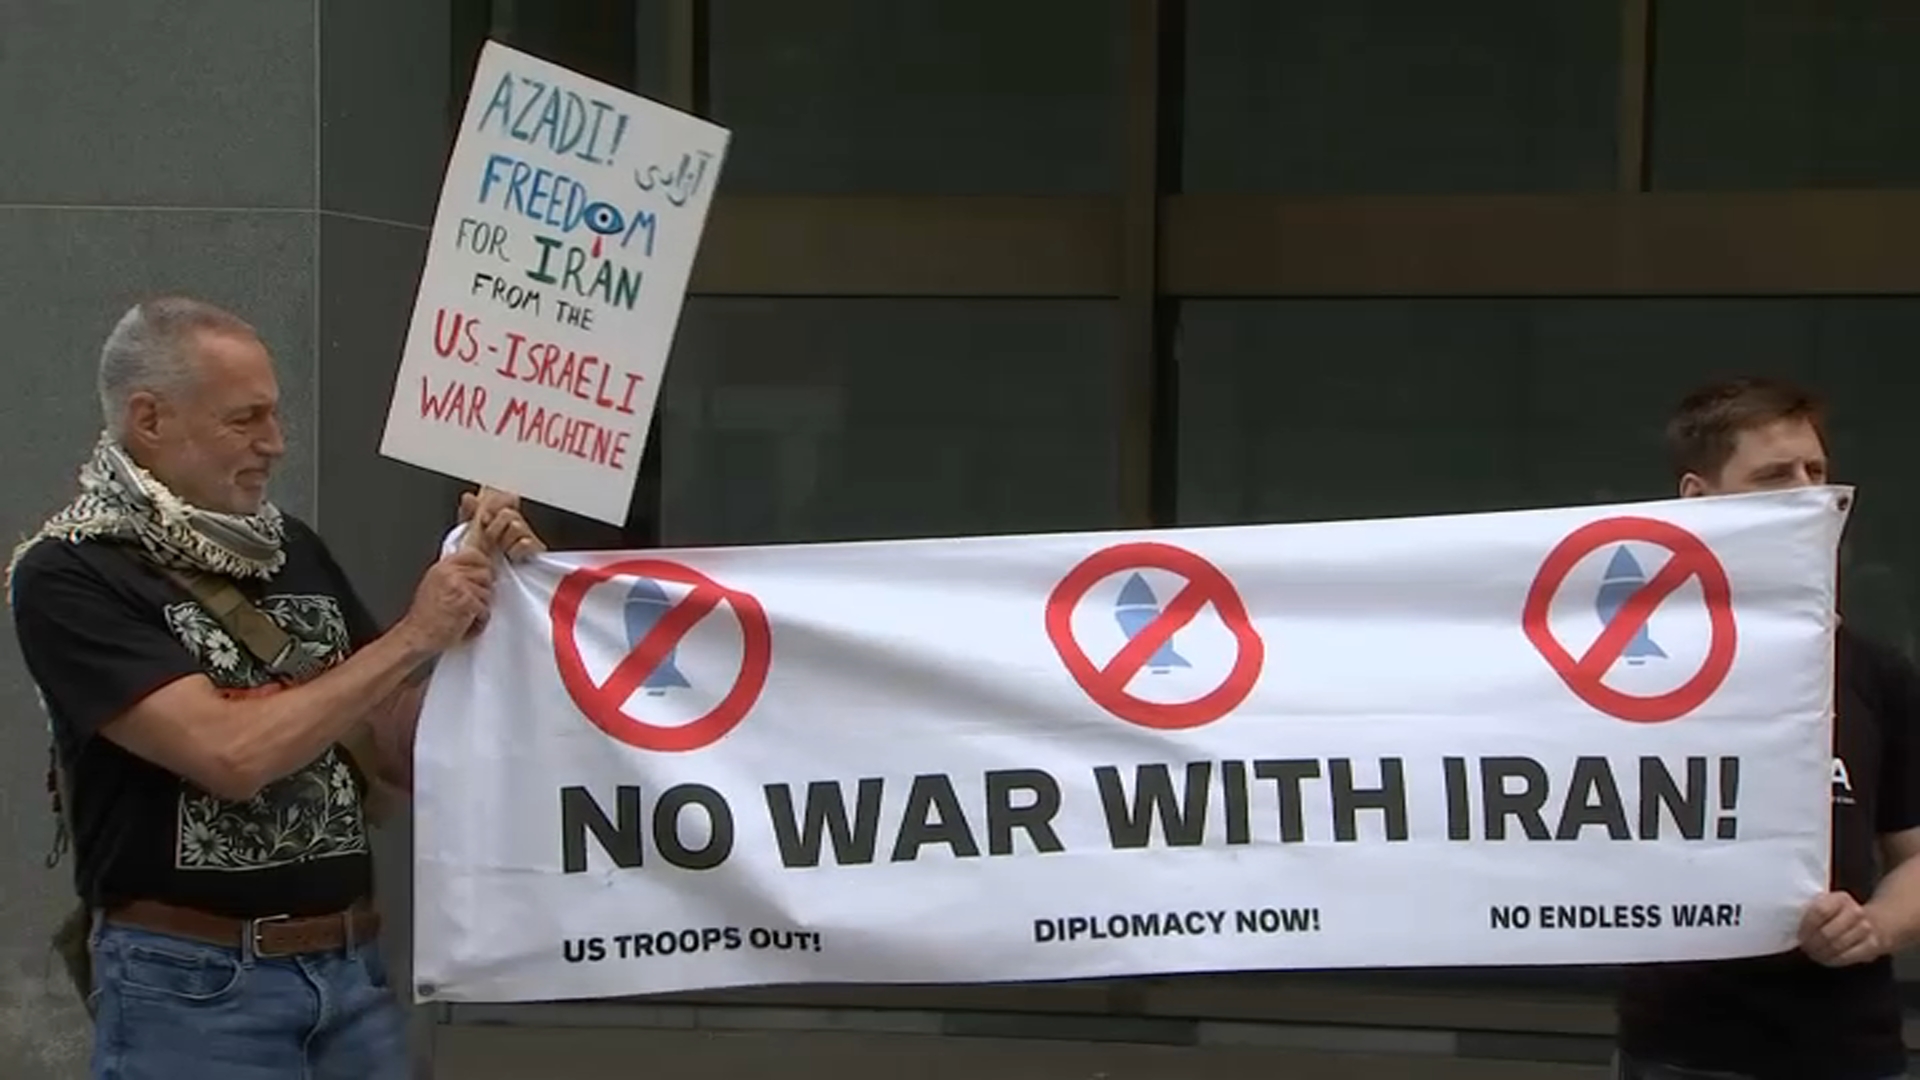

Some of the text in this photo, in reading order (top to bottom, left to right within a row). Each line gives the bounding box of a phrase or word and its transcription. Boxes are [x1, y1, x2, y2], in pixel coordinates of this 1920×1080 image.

[478, 72, 630, 167] AZADI!
[456, 218, 643, 310] FOR IRAN
[472, 273, 595, 331] FROM THE
[420, 376, 632, 470] WAR MACHINE
[560, 756, 1741, 874] NO WAR WITH IRAN!
[563, 927, 823, 963] US TROOPS OUT!
[1034, 908, 1320, 943] DIPLOMACY NOW!
[1490, 904, 1742, 929] NO ENDLESS WAR!
